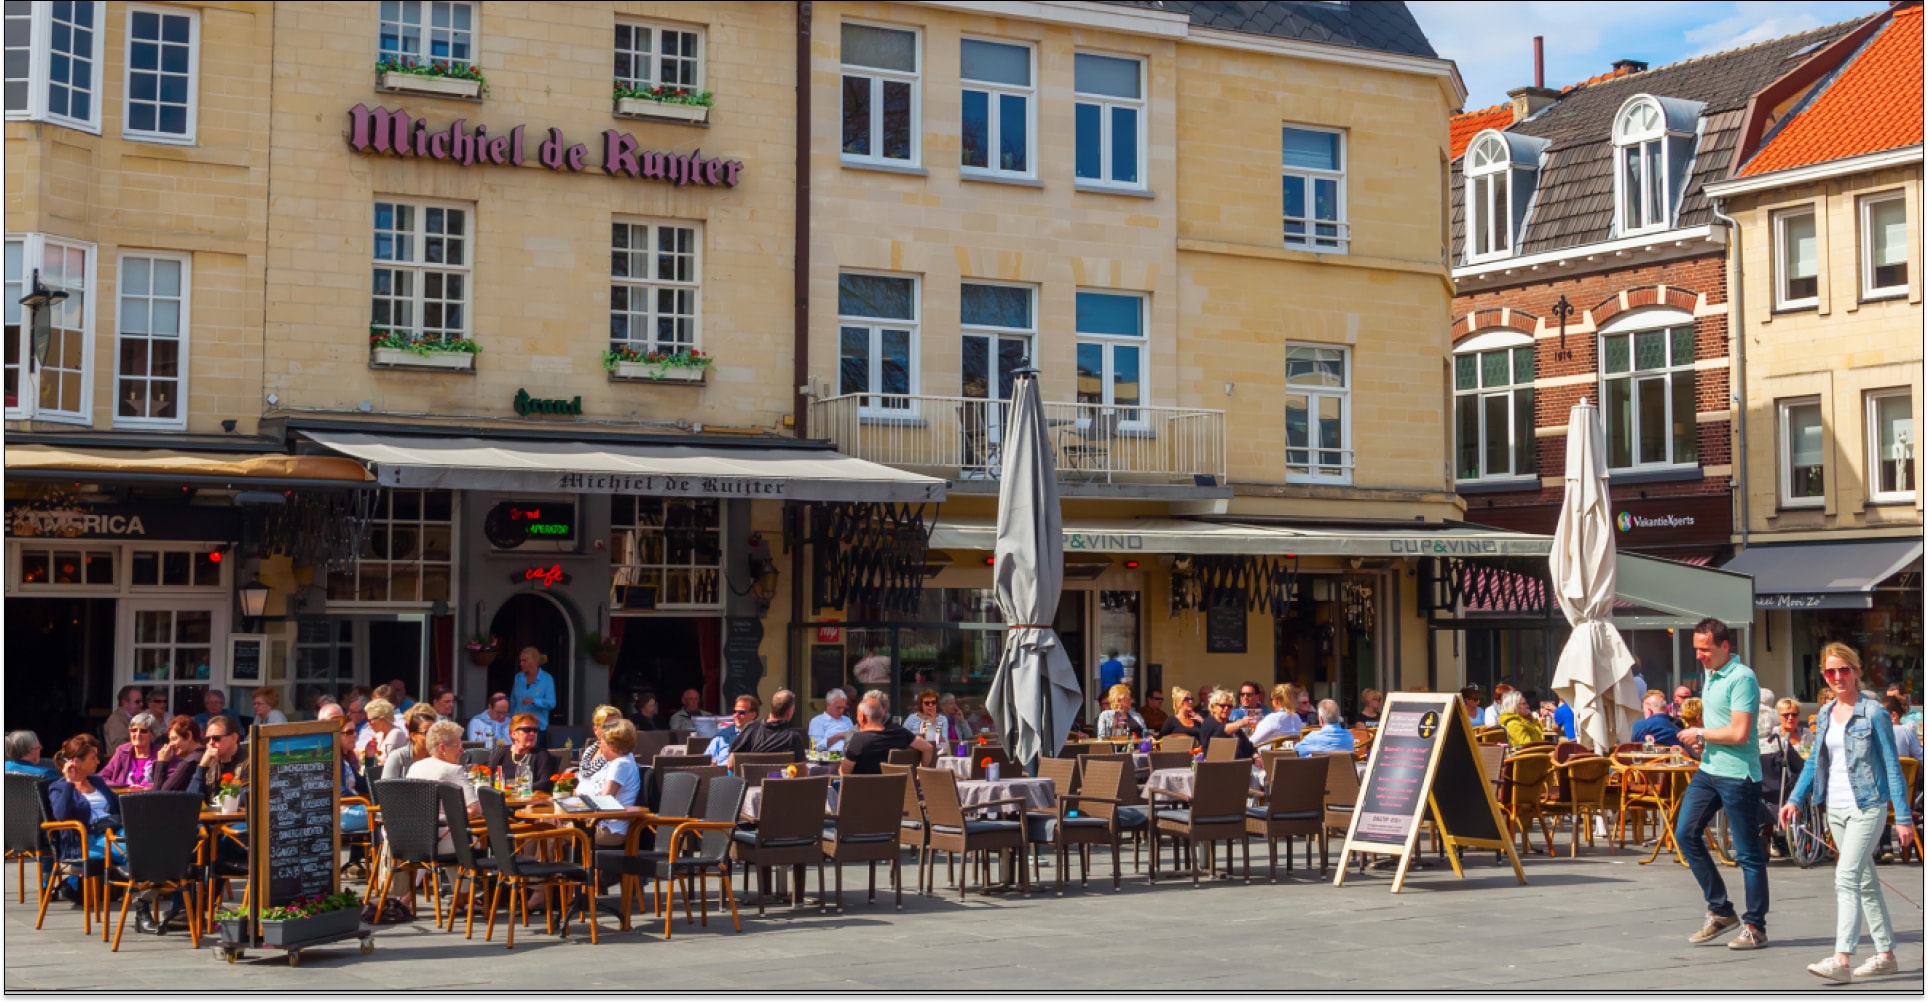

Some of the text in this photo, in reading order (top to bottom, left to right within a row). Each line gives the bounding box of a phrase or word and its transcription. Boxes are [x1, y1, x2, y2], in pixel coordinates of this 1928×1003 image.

[348, 102, 526, 167] Michiel
[539, 127, 588, 172] de
[559, 472, 653, 491] Michiel
[665, 474, 690, 491] de
[1633, 514, 1695, 528] VakantieXperts
